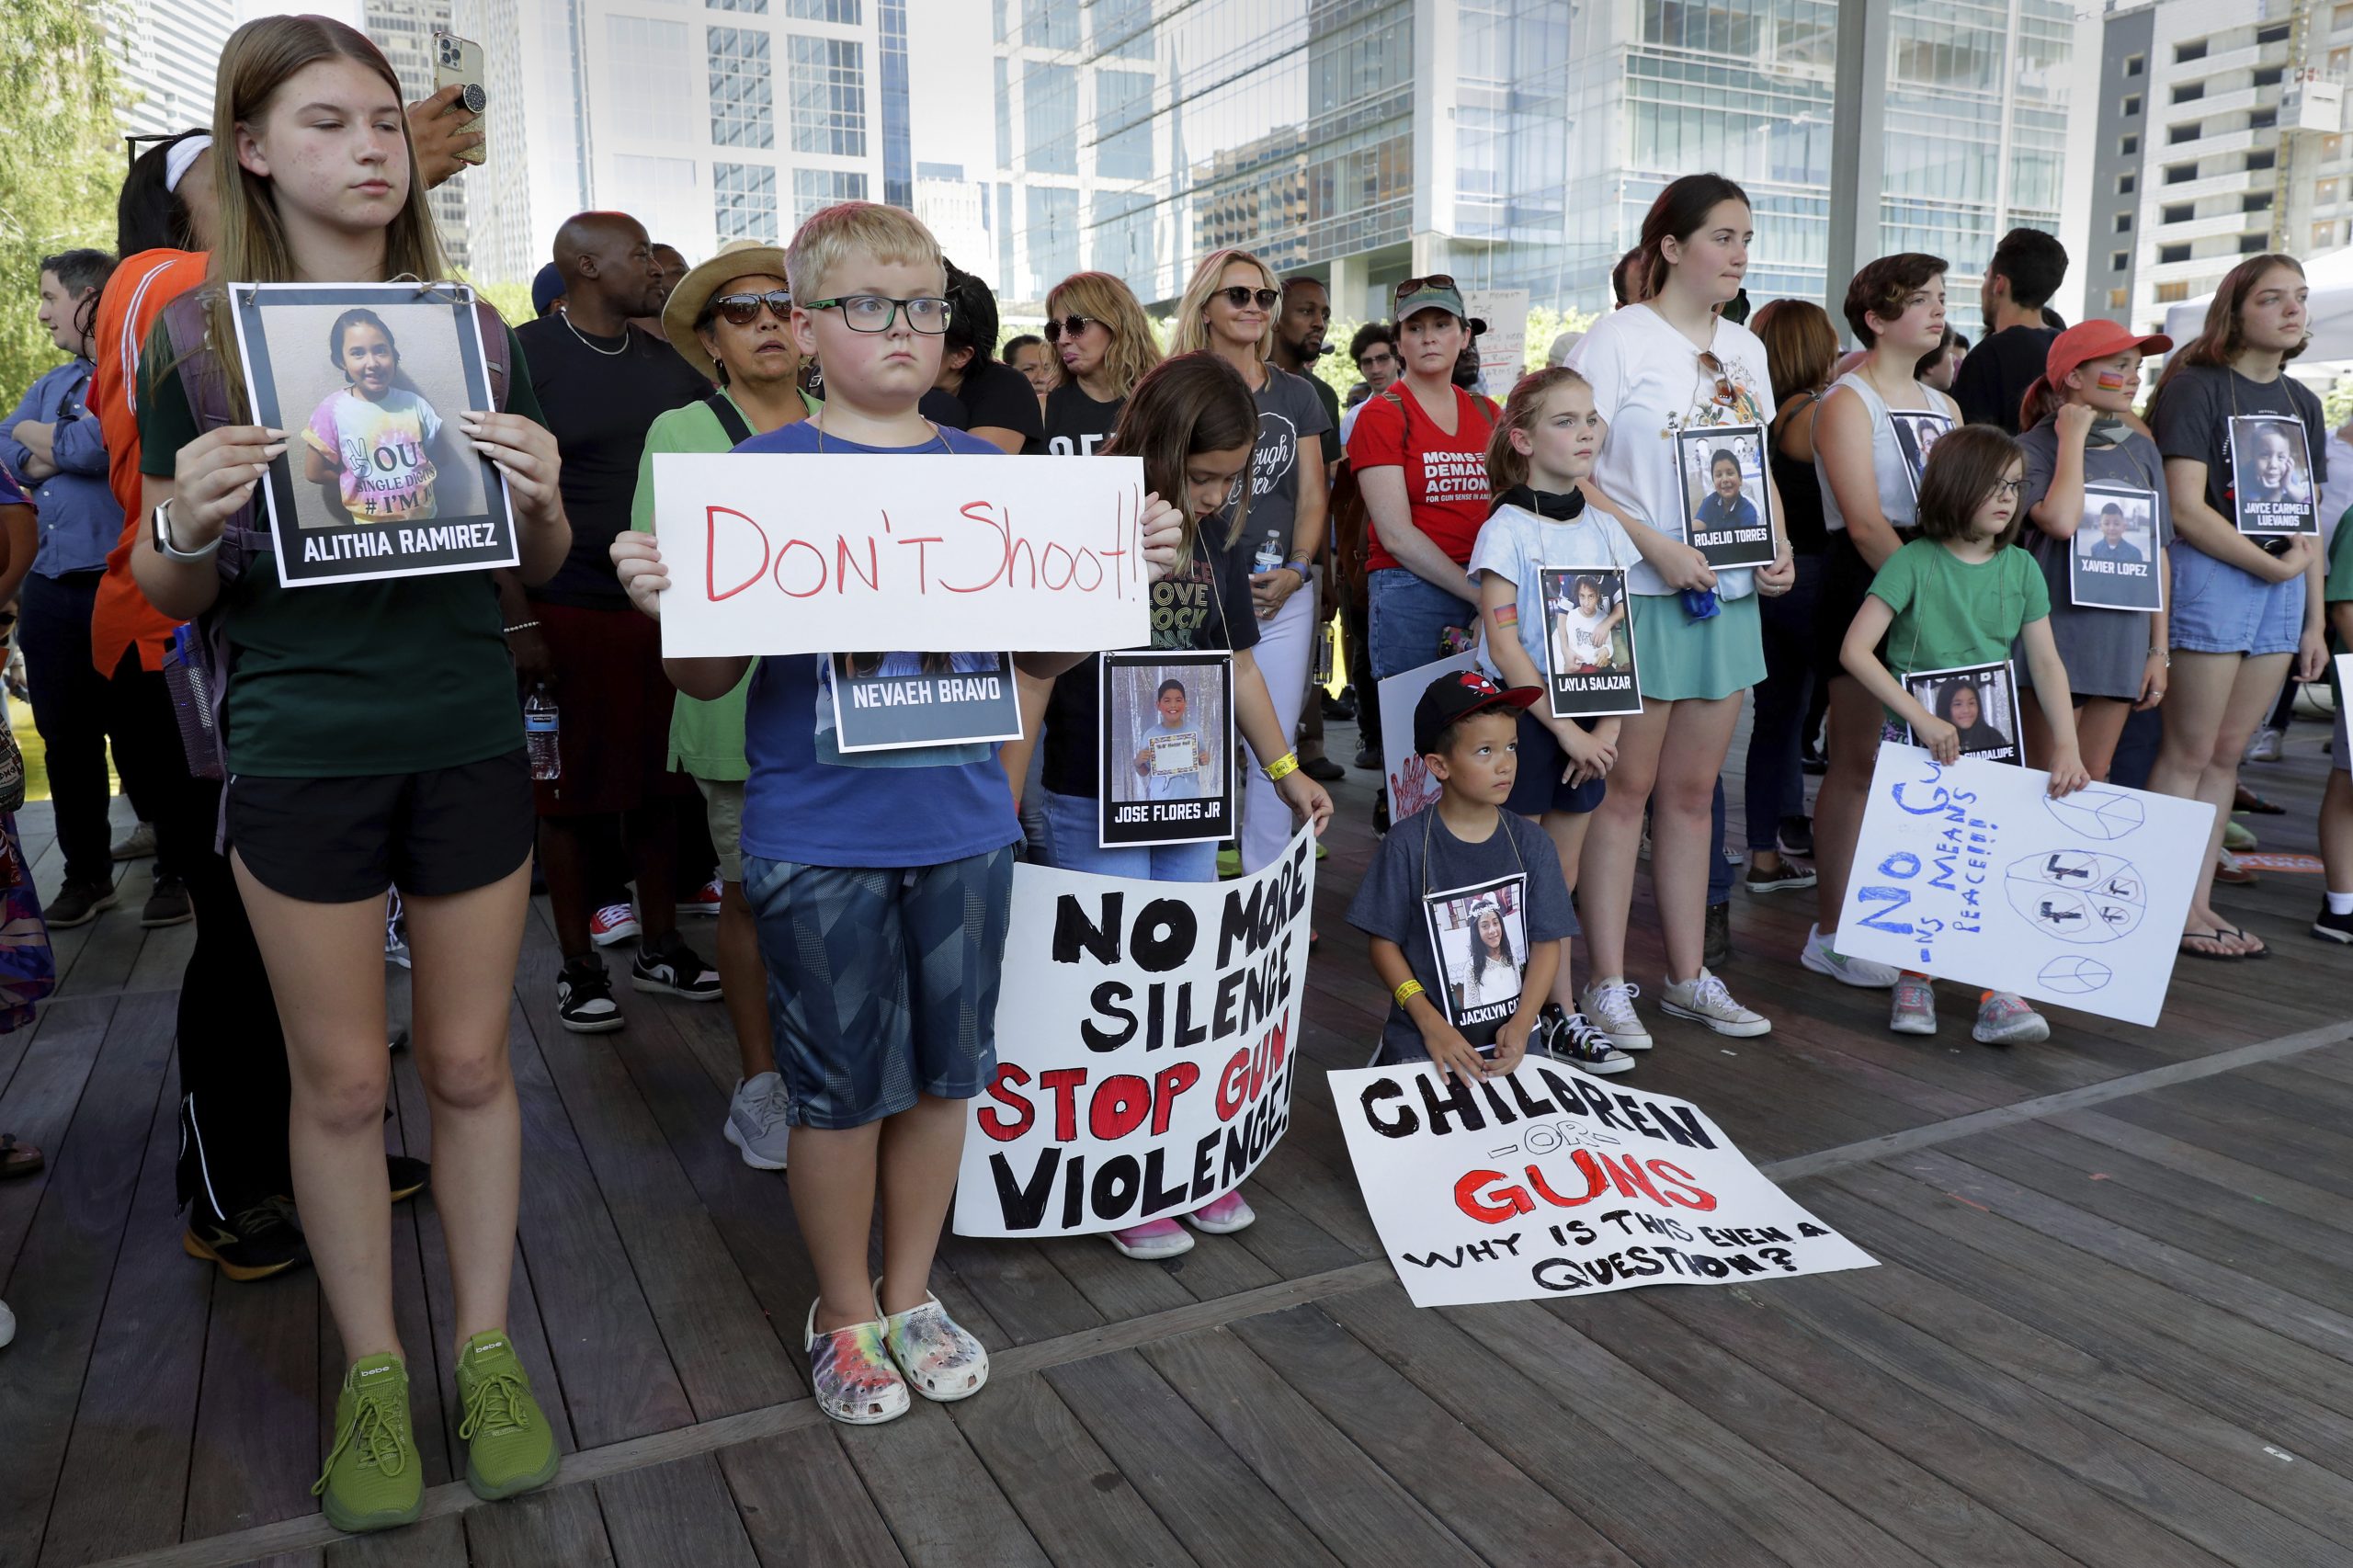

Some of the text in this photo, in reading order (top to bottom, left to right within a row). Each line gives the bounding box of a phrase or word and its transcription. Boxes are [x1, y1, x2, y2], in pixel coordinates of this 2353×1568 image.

[1423, 451, 1477, 463] MOMS
[404, 465, 436, 487] DIGITS
[1425, 463, 1488, 479] DEMAN
[355, 476, 404, 493] SINGLE
[1426, 478, 1490, 494] ACTION
[1440, 494, 1454, 503] GUN
[1455, 493, 1472, 501] SENSE
[2245, 502, 2311, 516] JAYCE CARMELO
[2257, 516, 2301, 527] LUEVANOS
[303, 522, 498, 563] ALITHIA RAMIREZ
[1694, 528, 1768, 547] ROJELIO TORRES
[706, 506, 944, 602] DON'T
[2081, 559, 2148, 577] XAVIER LOPEZ
[1150, 582, 1209, 607] OVE
[852, 676, 1001, 709] NEVAEH BRAVO
[1559, 676, 1631, 692] LAYLA SALAZAR
[1115, 801, 1221, 823] JOSE FLORES JR
[1927, 787, 1977, 892] MEANS
[1051, 836, 1308, 972] NO MORE
[1857, 851, 1922, 936] NO
[1080, 929, 1292, 1052] SILENCE
[1459, 1003, 1507, 1027] JACKLYN
[977, 1007, 1290, 1142] STOP GUN
[1360, 1067, 1719, 1150] CHILDREN
[988, 1048, 1296, 1231] VIOLENCE!
[1454, 1148, 1717, 1225] GUNS
[1402, 1210, 1832, 1269] WHY IS THIS EVEN A
[1531, 1246, 1799, 1291] QUESTION?
[475, 1341, 503, 1354] bebe
[361, 1366, 390, 1378] bebe
